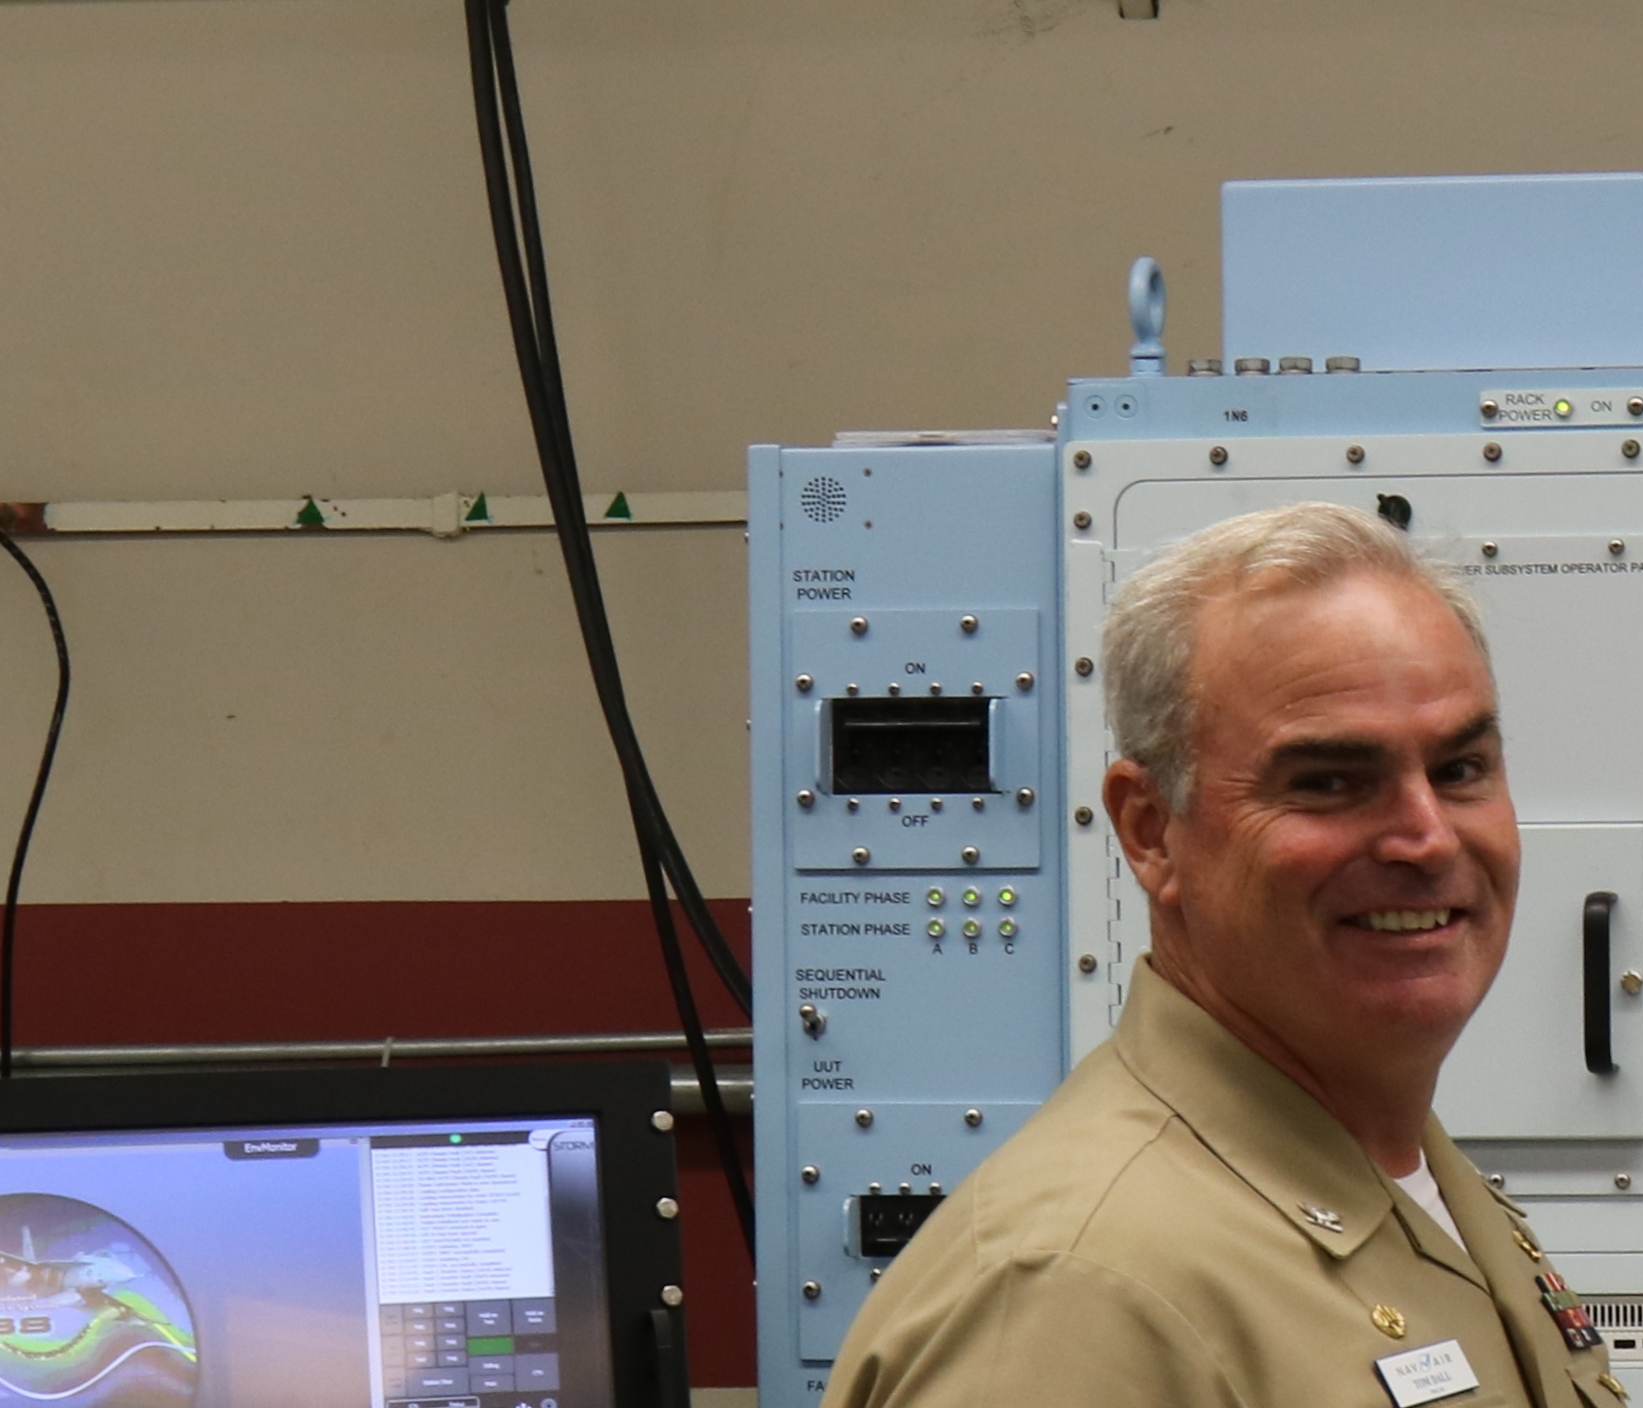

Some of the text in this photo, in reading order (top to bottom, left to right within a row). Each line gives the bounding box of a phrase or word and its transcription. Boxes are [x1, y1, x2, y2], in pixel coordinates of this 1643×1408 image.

[1506, 394, 1545, 406] RACK
[1591, 400, 1612, 413] ON
[1499, 408, 1551, 422] POWER
[1486, 563, 1557, 575] SUBSYSTEM
[1561, 562, 1626, 574] OPERATOR
[793, 570, 855, 582] STATION
[797, 587, 852, 600] POWER
[905, 662, 926, 674] ON
[902, 815, 929, 827] OFF
[801, 891, 910, 904] FACILITY PHASE
[801, 923, 910, 936] STATION PHASE
[934, 943, 1014, 955] A B C
[796, 968, 886, 982] SEQUENTIAL
[800, 988, 881, 1000] SHUTDOWN
[814, 1061, 842, 1073] UUT
[802, 1078, 854, 1090] POWER
[244, 1141, 298, 1153] EnvMonitor
[911, 1164, 931, 1175] ON
